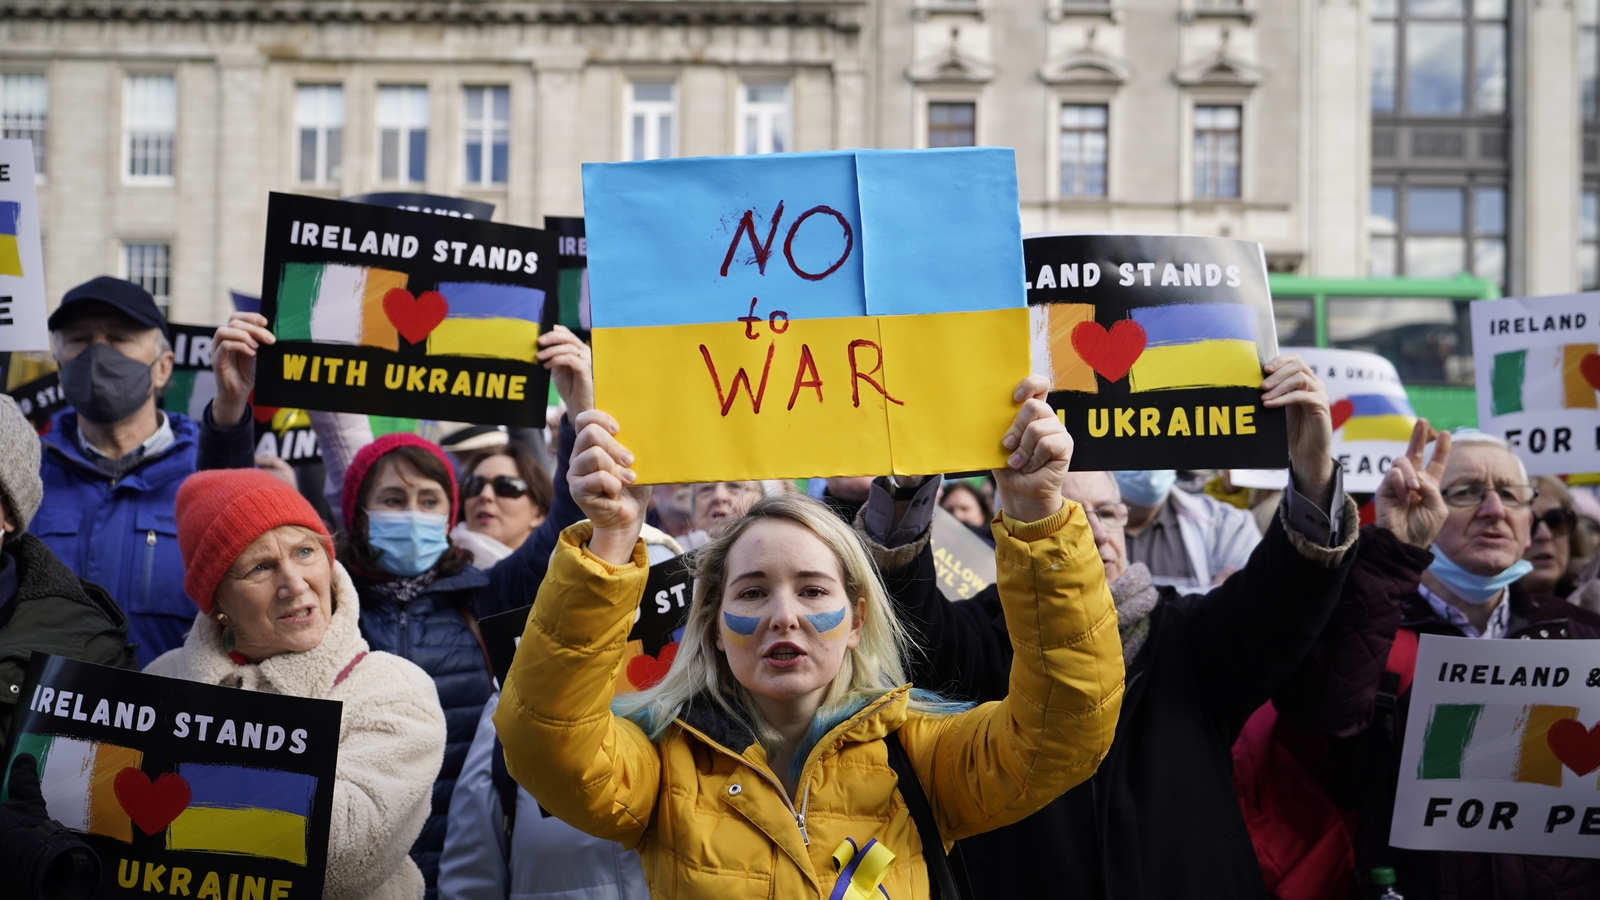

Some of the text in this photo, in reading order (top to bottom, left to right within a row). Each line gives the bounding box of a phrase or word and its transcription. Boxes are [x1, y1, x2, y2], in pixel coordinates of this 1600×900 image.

[290, 221, 539, 274] IRELAND STANDS
[720, 200, 853, 281] NO
[1119, 263, 1241, 287] STANDS
[738, 297, 789, 339] to
[1490, 313, 1587, 335] IRELAND
[283, 354, 527, 400] WITH UKRAINE
[699, 339, 904, 416] WAR
[1088, 406, 1256, 437] UKRAINE
[1505, 427, 1572, 455] FOR
[255, 429, 322, 460] AIN
[934, 547, 988, 592] ALLOW
[1438, 662, 1569, 687] IRELAND
[30, 685, 308, 754] IRELAND STANDS
[1424, 798, 1518, 831] FOR
[117, 859, 292, 900] UKRAINE
